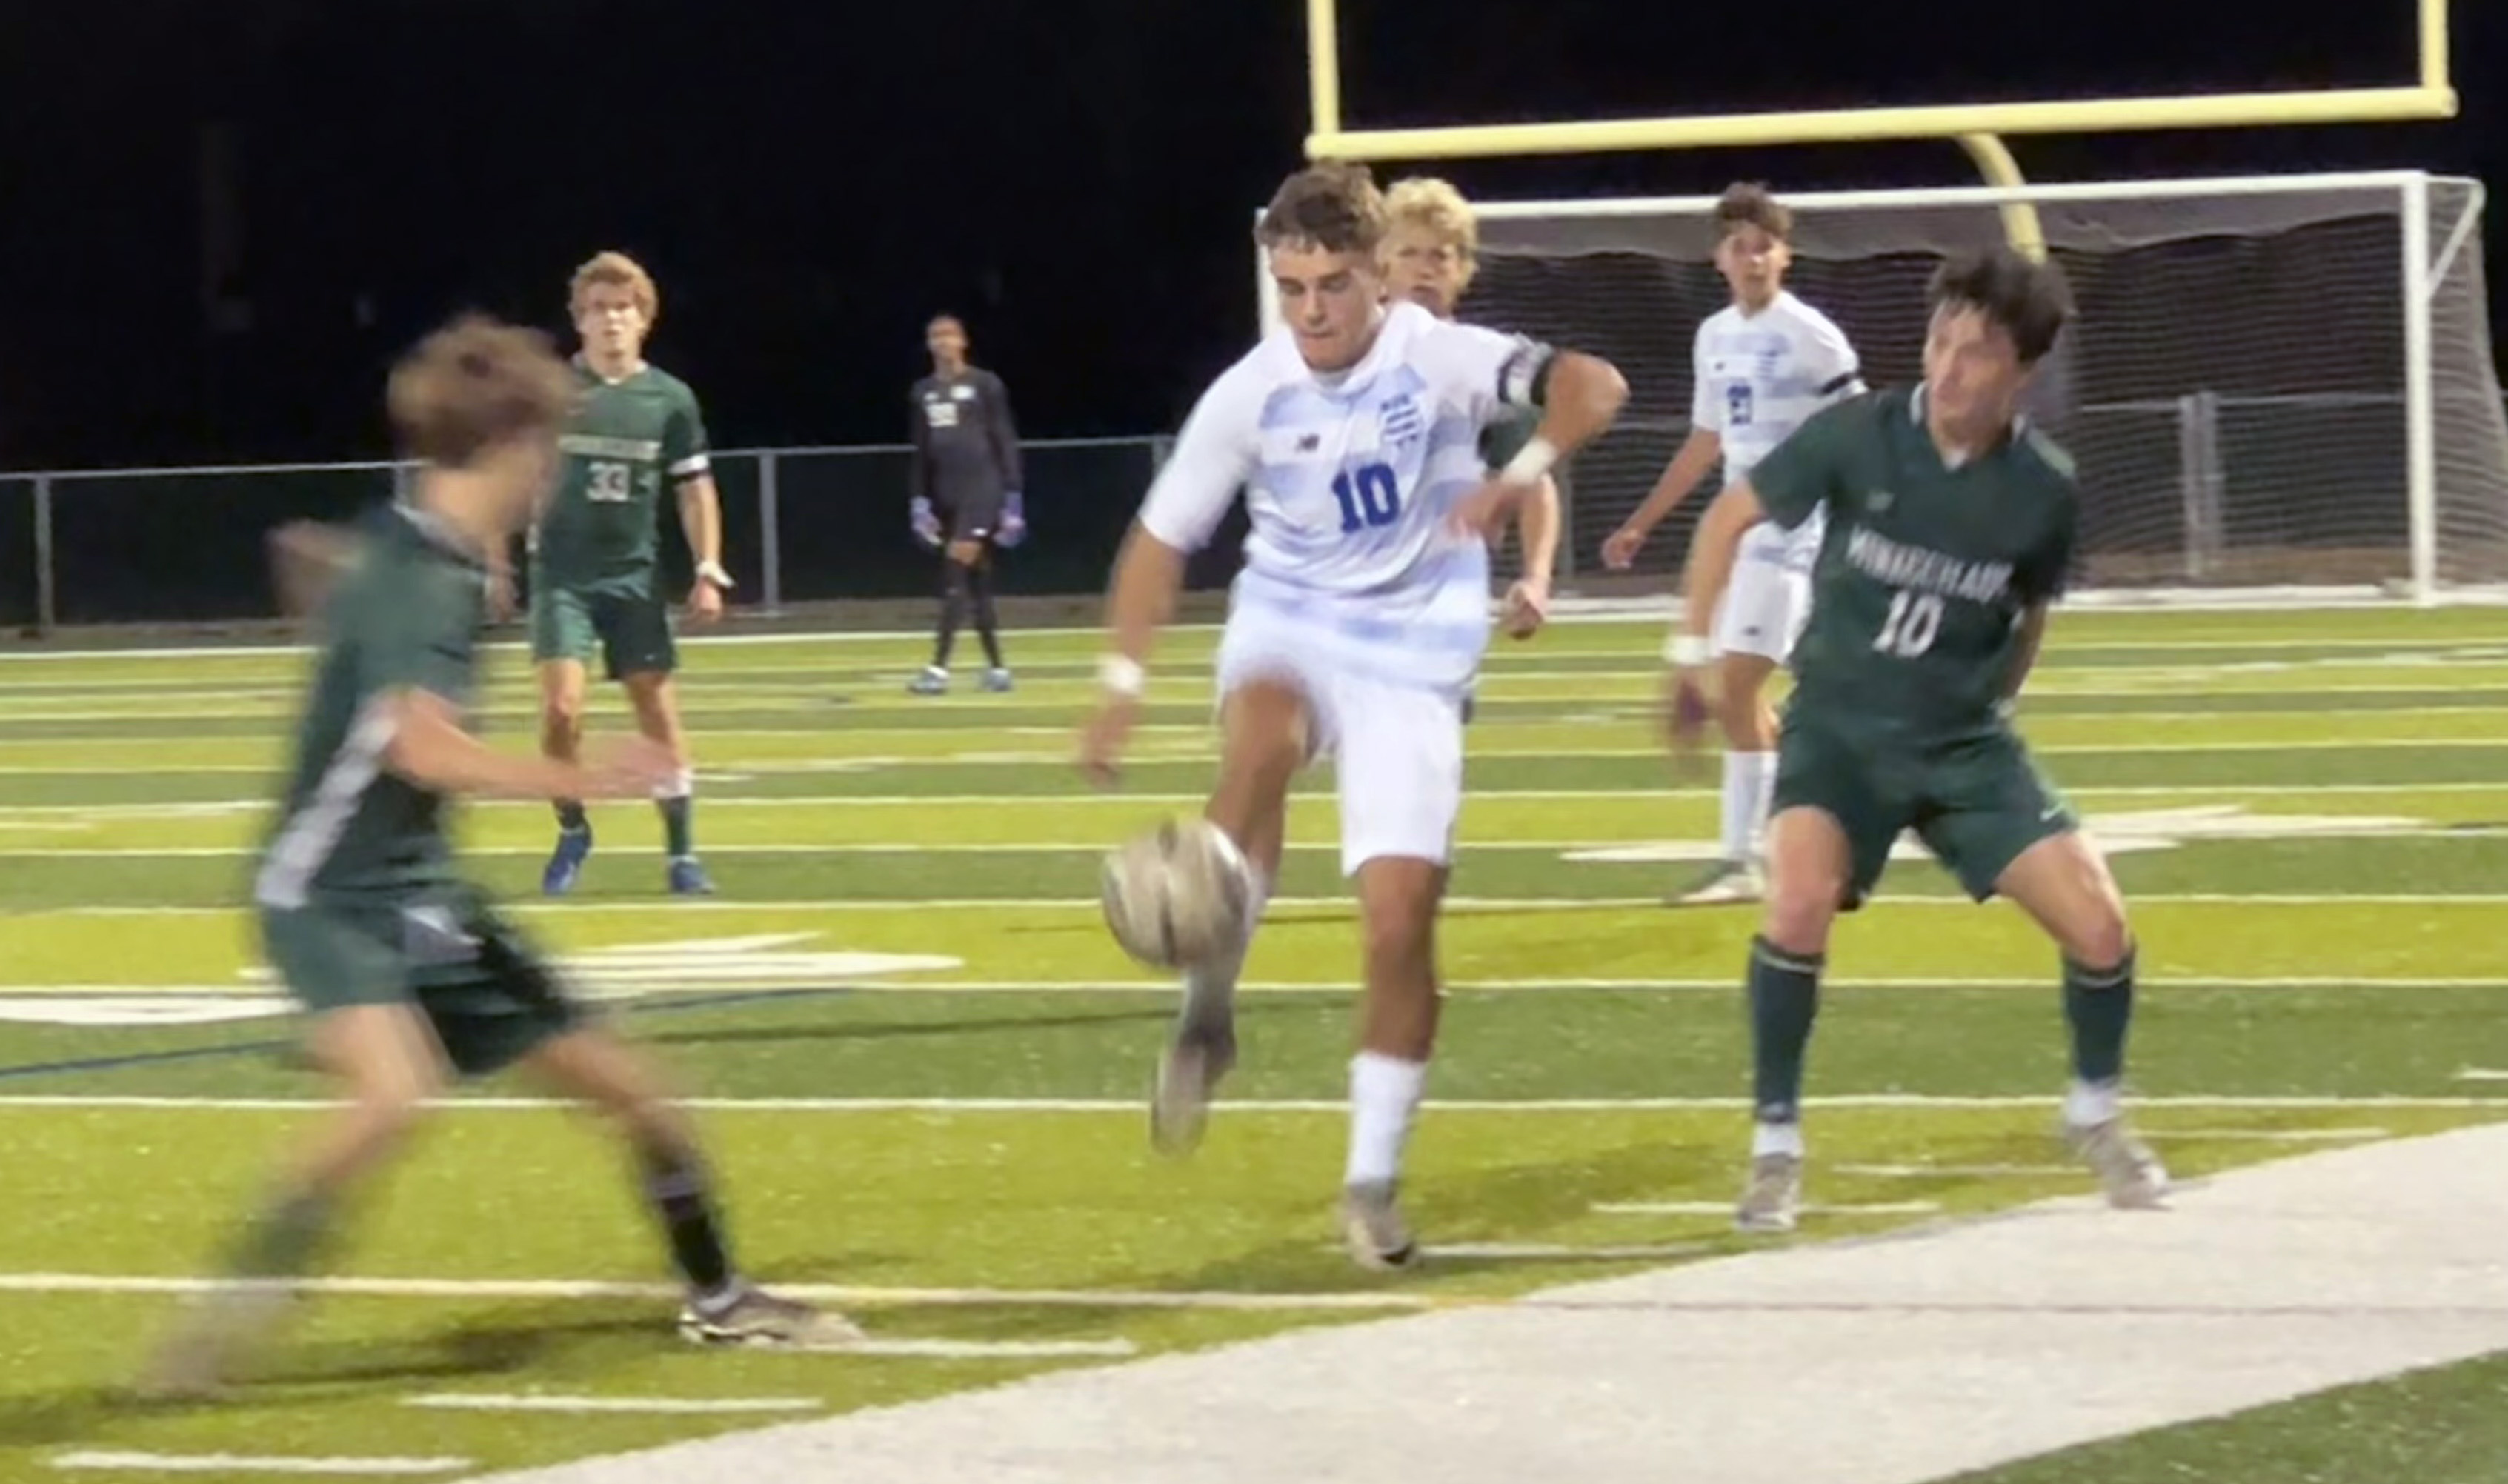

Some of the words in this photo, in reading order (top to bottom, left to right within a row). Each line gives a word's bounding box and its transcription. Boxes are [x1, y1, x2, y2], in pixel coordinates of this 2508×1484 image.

[587, 461, 629, 502] 33
[1332, 462, 1400, 533] 10
[1872, 590, 1946, 658] 10
